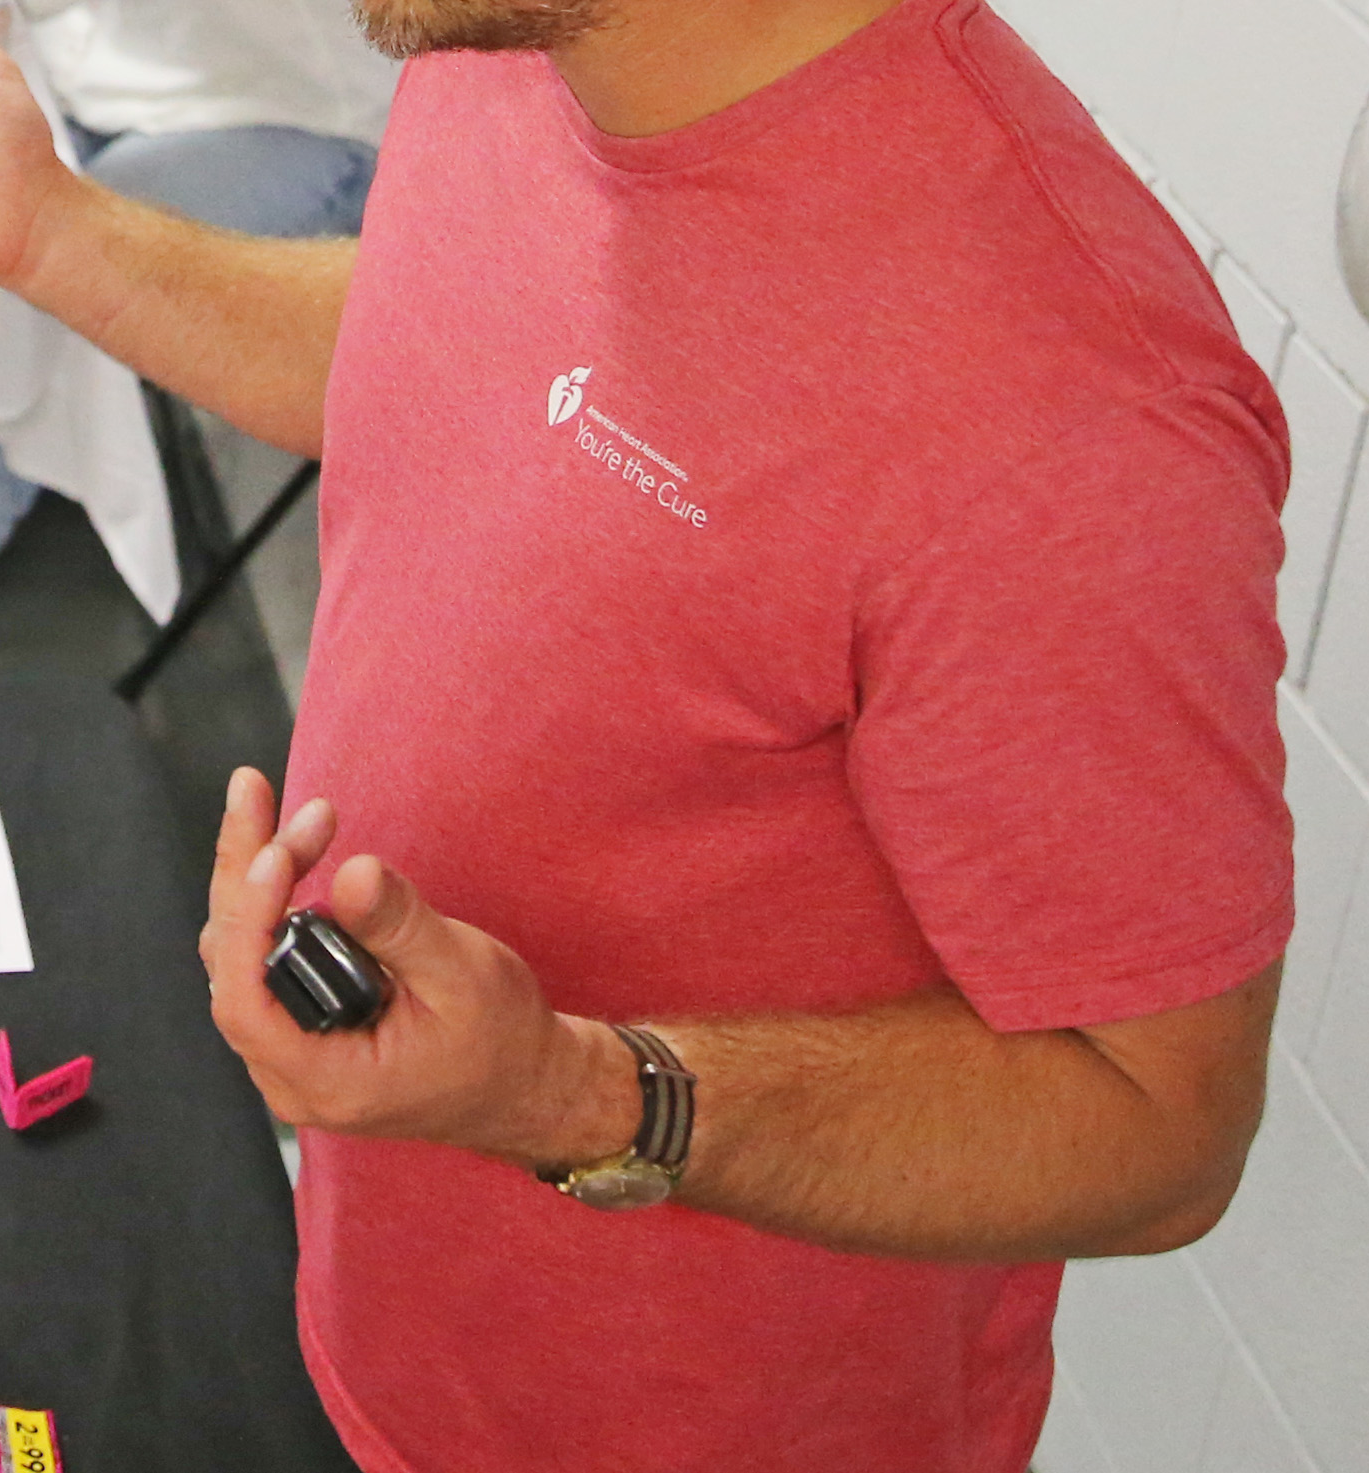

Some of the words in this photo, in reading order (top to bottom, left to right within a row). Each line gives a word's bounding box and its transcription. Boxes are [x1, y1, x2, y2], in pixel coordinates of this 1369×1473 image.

[585, 405, 619, 434] American
[618, 427, 643, 450] Heart
[574, 418, 622, 471] You're
[622, 457, 655, 494] the
[657, 481, 708, 528] Cure
